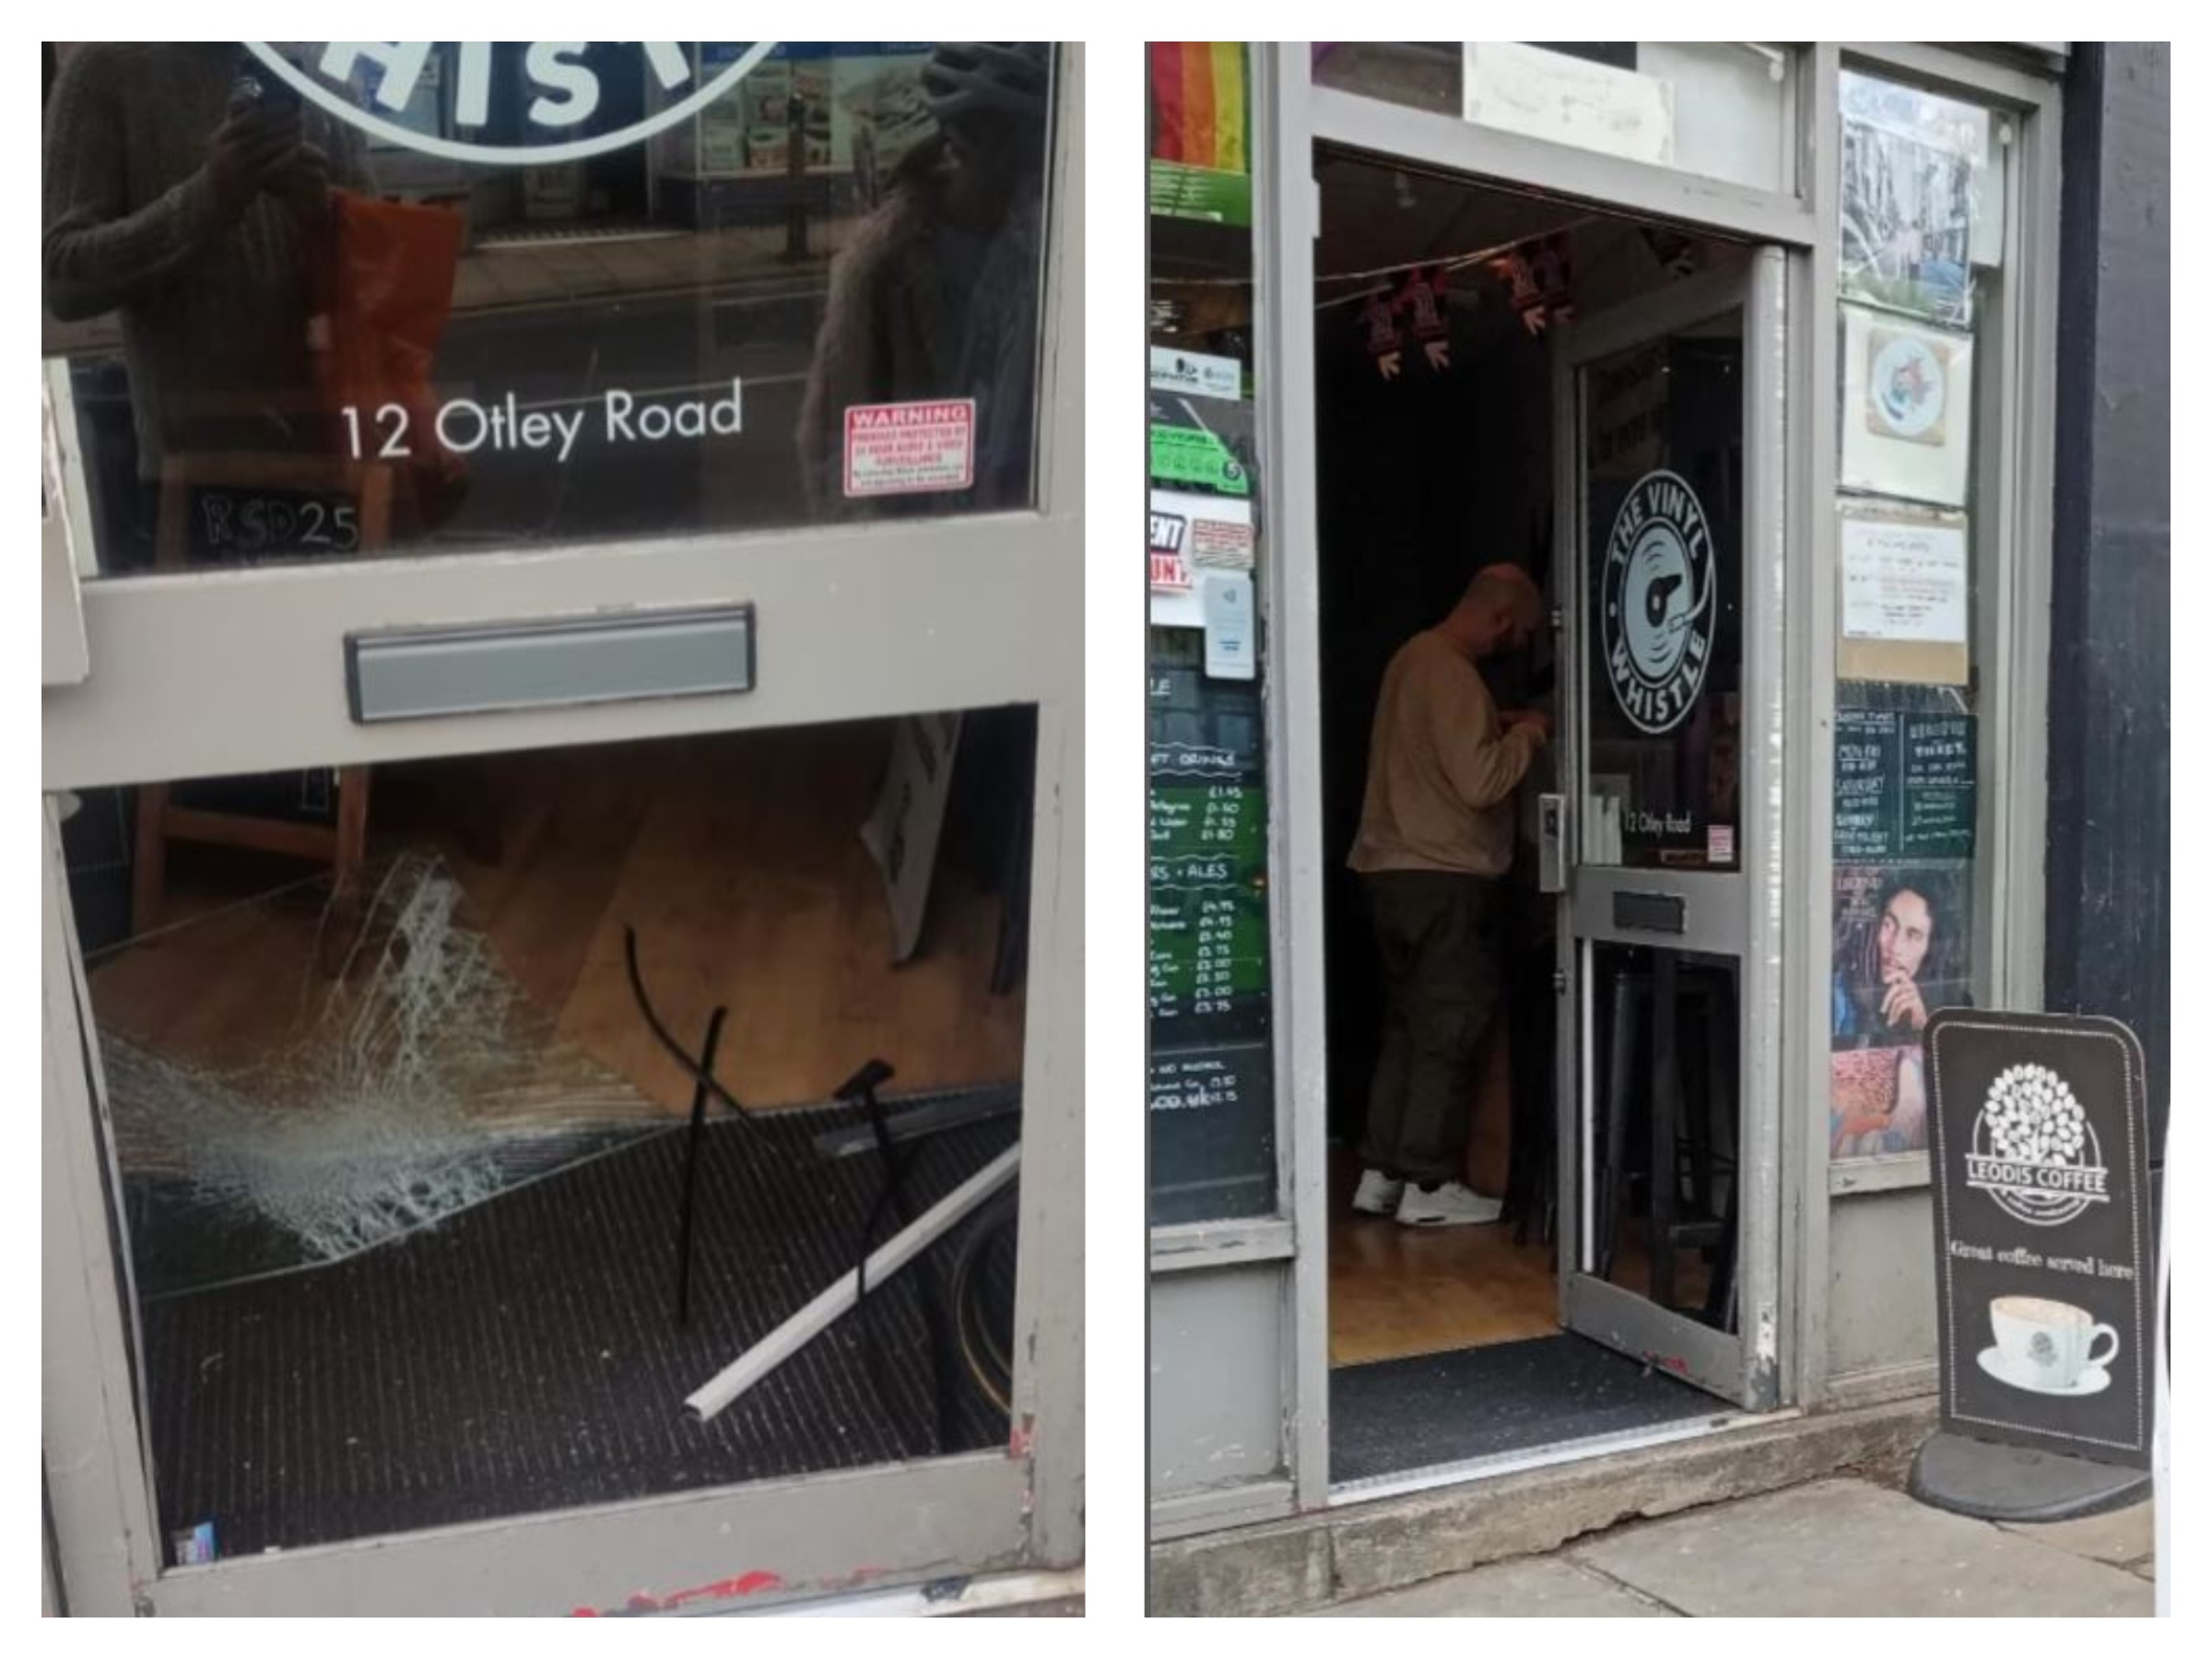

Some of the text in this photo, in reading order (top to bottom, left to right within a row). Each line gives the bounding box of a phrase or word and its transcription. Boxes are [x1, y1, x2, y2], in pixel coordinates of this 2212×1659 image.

[341, 376, 743, 463] 12 Otley Road
[853, 404, 967, 428] WARNING
[1611, 482, 1705, 566] THE VINYL
[1610, 629, 1707, 723] WHISTLE
[1624, 811, 1637, 832] 12
[1665, 810, 1692, 834] Road
[1186, 864, 1229, 879] ALES
[1967, 1158, 2107, 1194] LEODIS COFFEE
[1949, 1240, 2135, 1280] Great coffee served here
